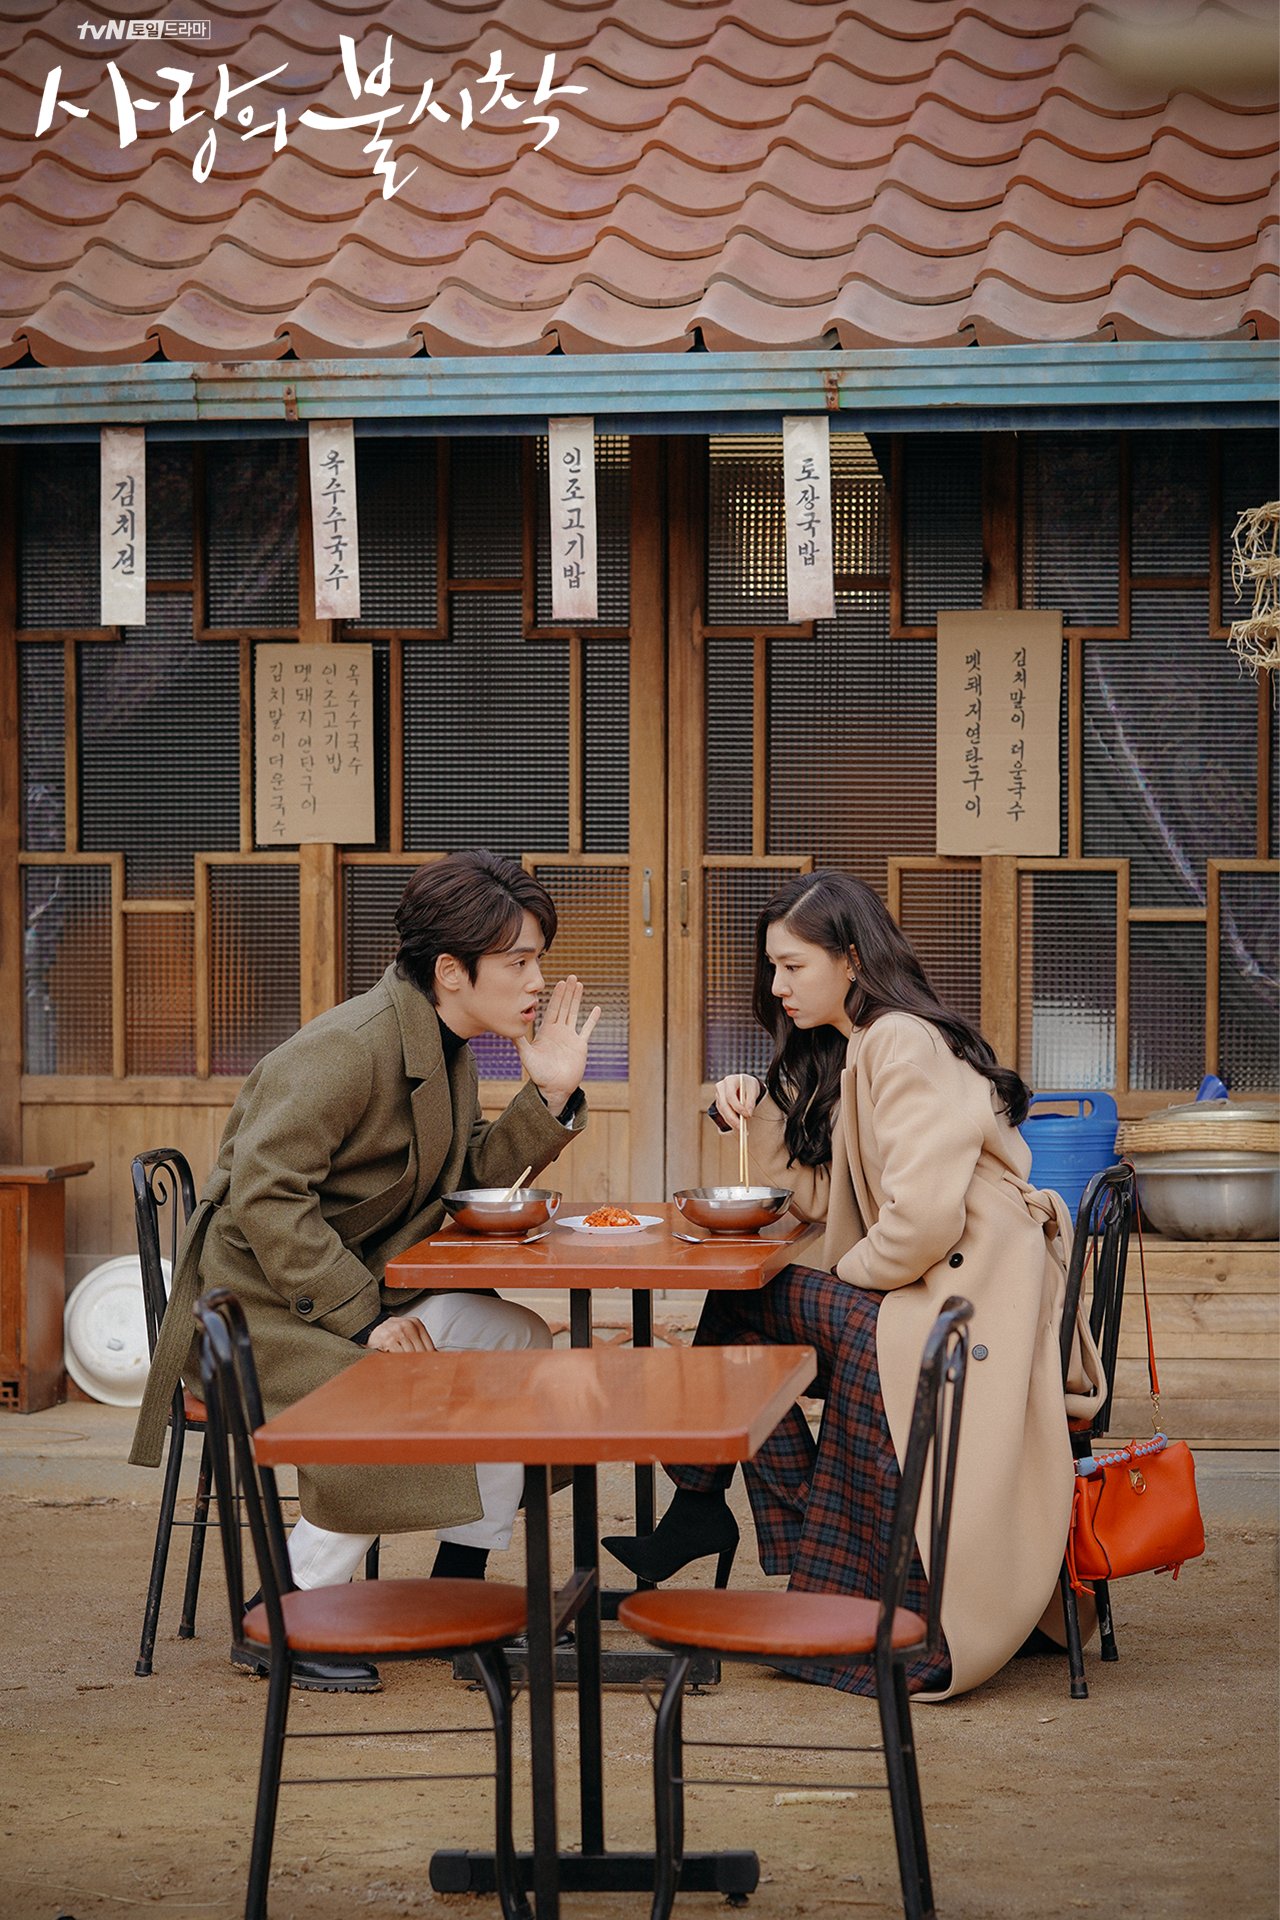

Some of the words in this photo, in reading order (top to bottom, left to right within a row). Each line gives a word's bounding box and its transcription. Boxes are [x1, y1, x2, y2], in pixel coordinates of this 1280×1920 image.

[111, 475, 136, 576] 김치전
[319, 449, 349, 591] 옥수수국수
[561, 447, 586, 589] 인조고기밥
[795, 457, 821, 567] 토장국밥
[322, 663, 342, 774] 인조고기밥
[345, 664, 364, 775] 옥수수국수
[1010, 647, 1027, 730] 김치말이
[1006, 739, 1028, 822] 더운국수
